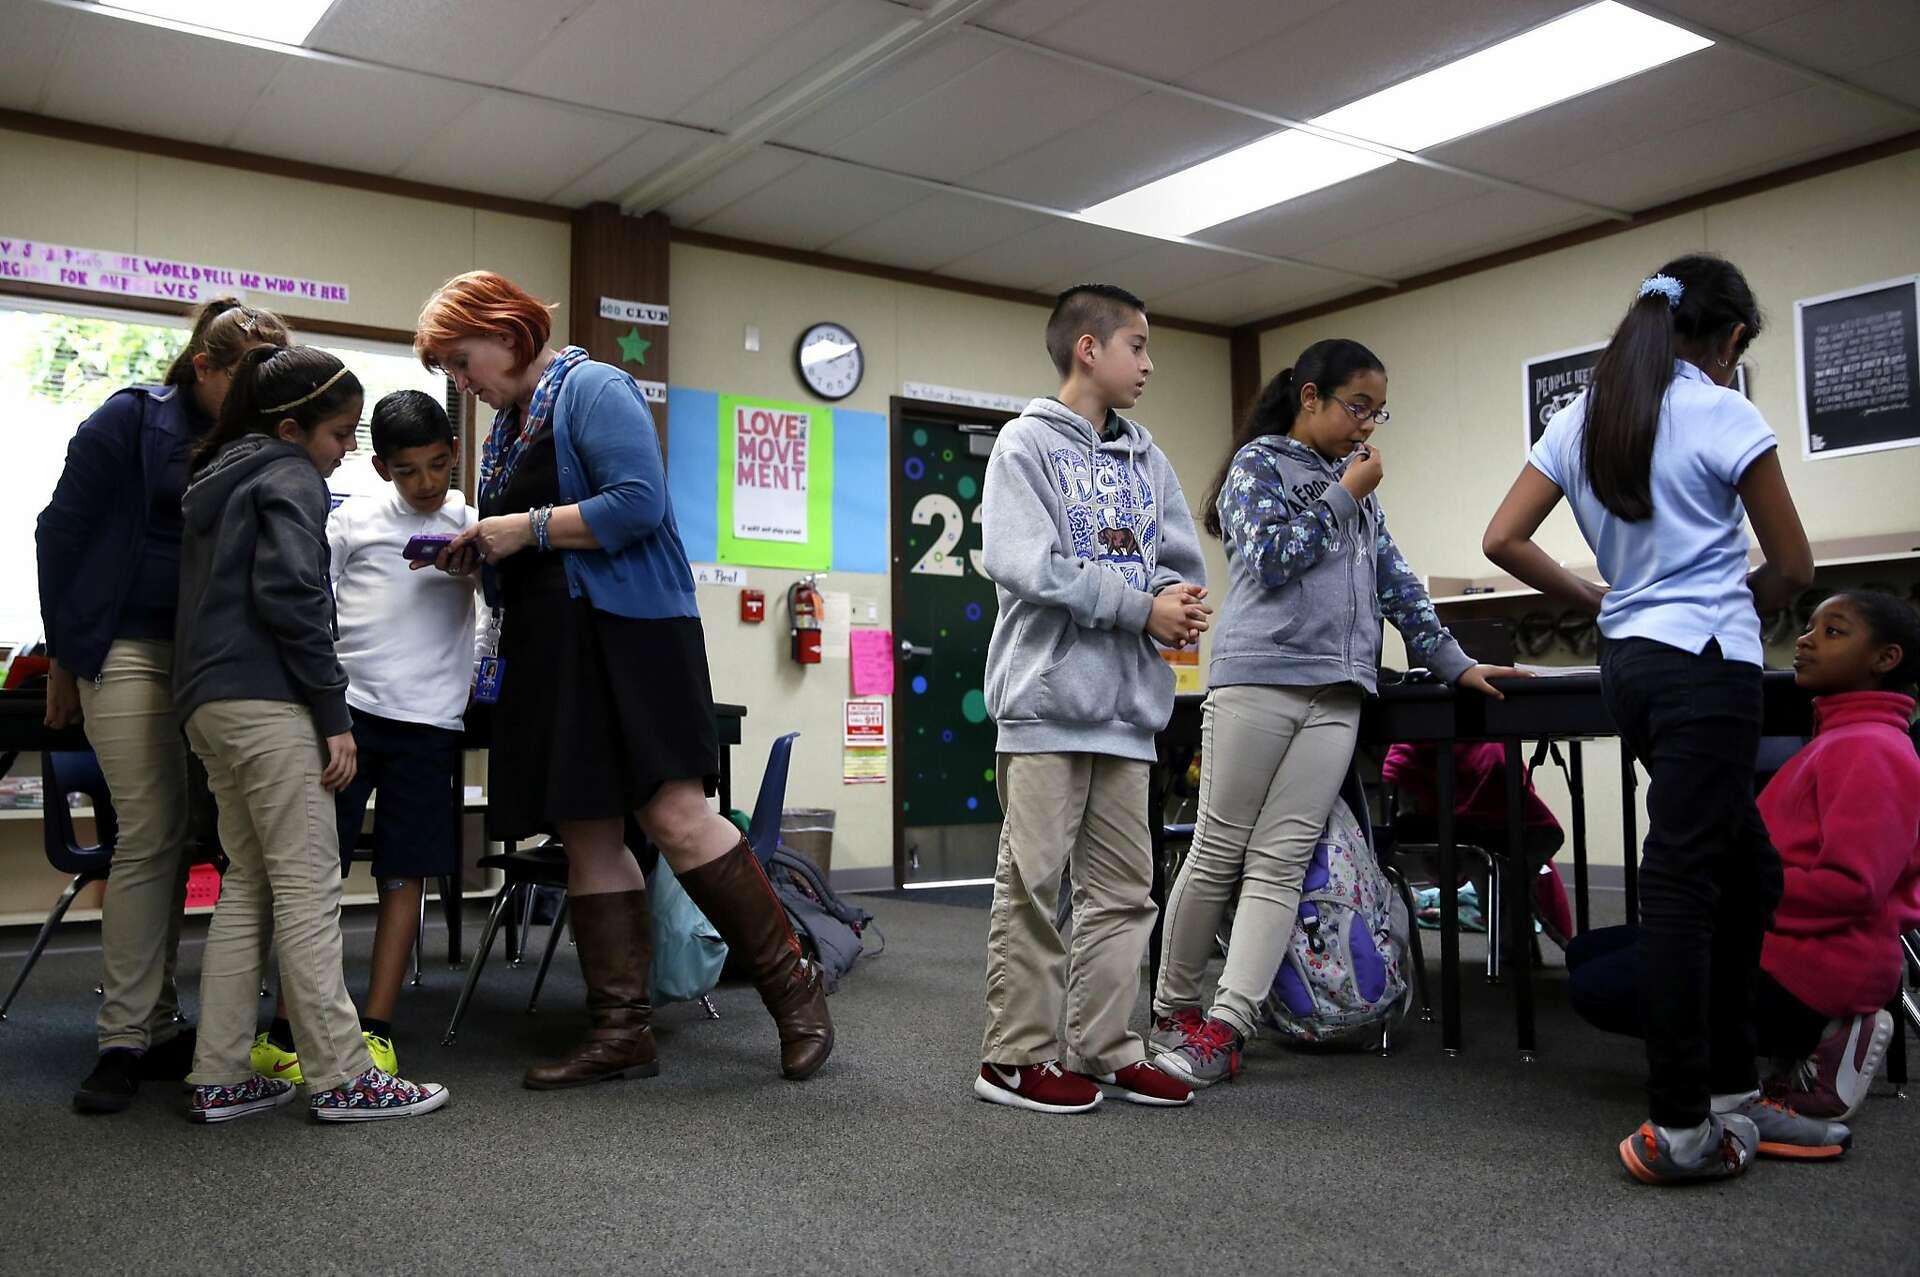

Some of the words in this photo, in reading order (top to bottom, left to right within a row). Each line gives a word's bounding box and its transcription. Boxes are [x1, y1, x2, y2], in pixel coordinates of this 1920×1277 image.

[60, 268, 87, 285] FOR
[144, 259, 201, 281] WORLD
[203, 267, 234, 285] TELL
[265, 276, 295, 293] WHO
[627, 308, 668, 322] CLUB
[1536, 373, 1571, 405] PEOPLE
[737, 409, 799, 440] LOVE
[738, 435, 805, 466] MOVE
[865, 716, 880, 724] 911
